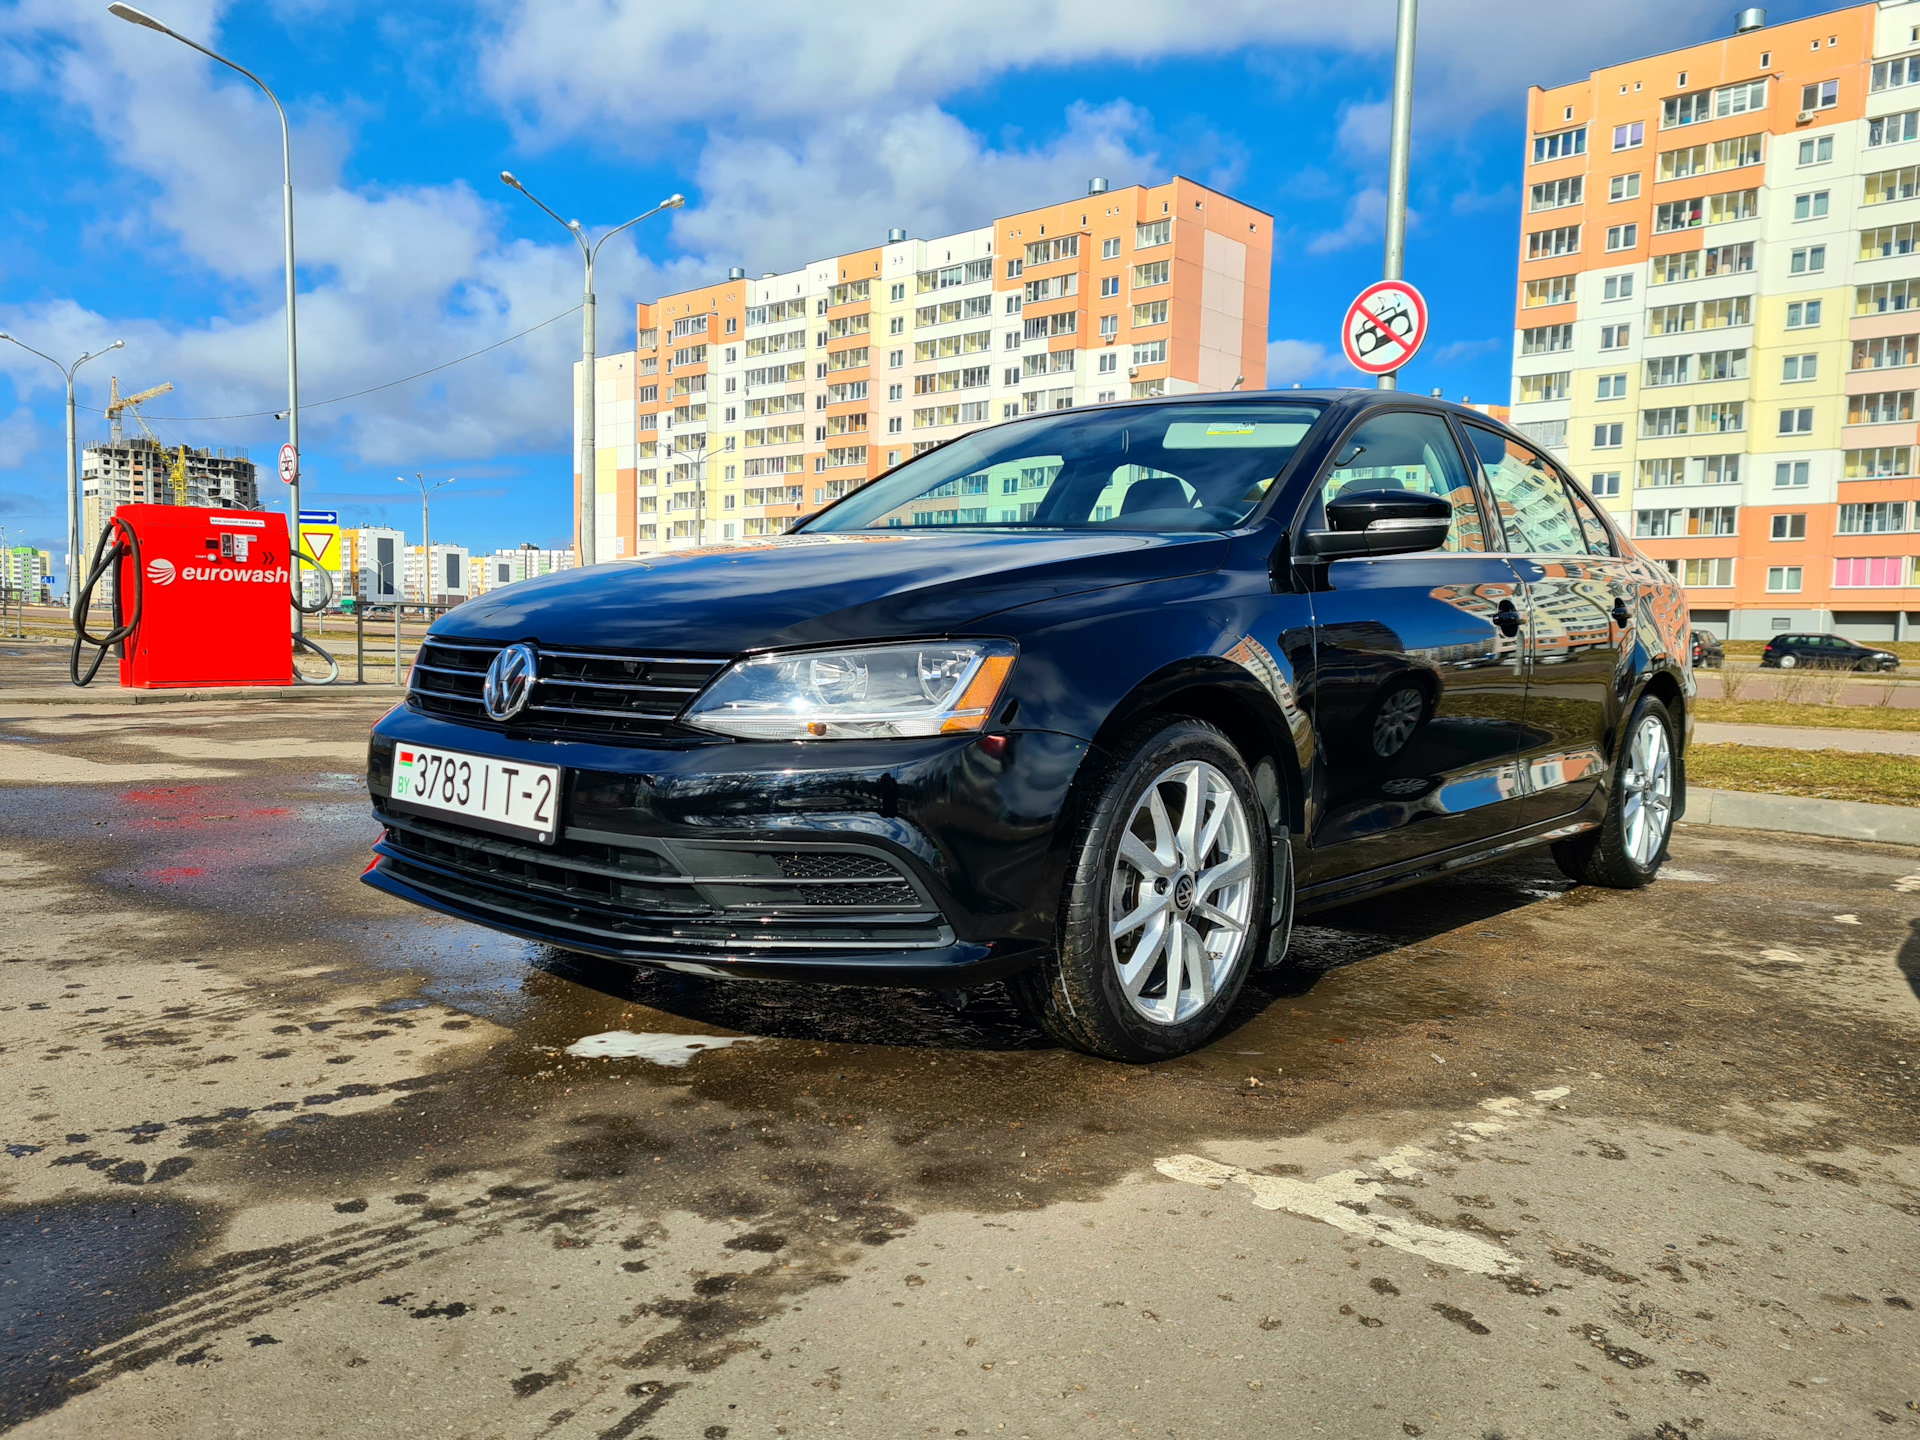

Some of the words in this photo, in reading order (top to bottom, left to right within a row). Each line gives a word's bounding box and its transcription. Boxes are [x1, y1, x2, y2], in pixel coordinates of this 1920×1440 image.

[182, 566, 289, 583] eurowash
[397, 775, 411, 795] BY
[414, 753, 472, 806] 3783
